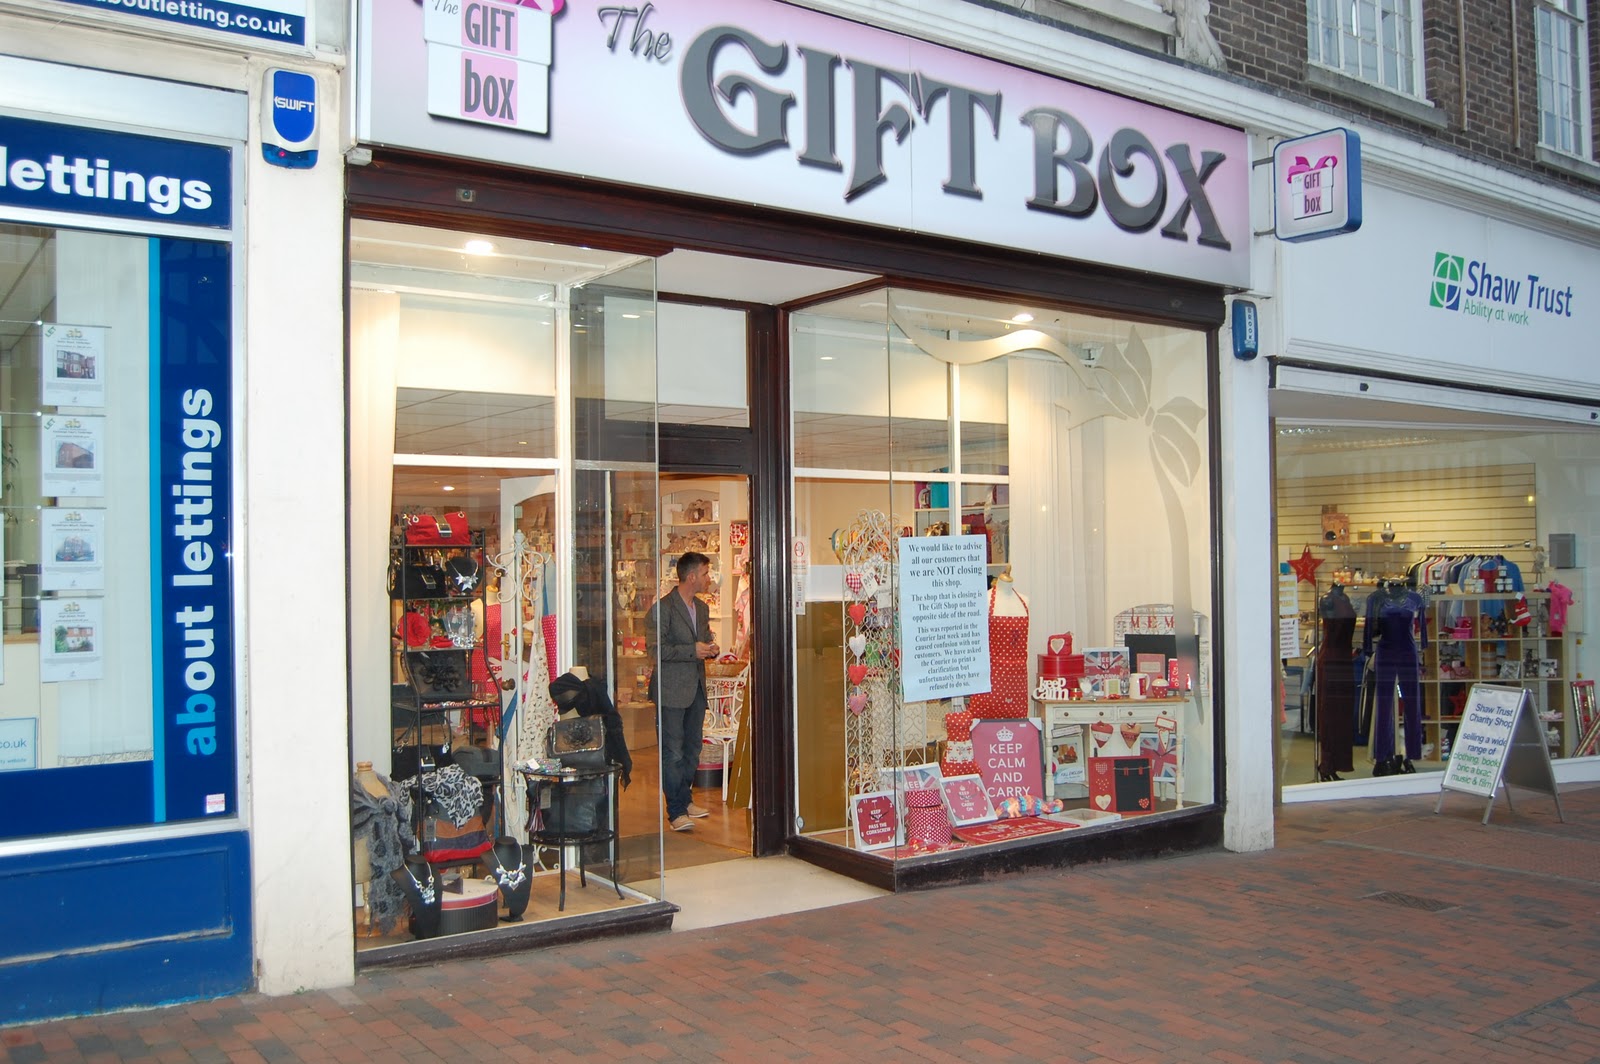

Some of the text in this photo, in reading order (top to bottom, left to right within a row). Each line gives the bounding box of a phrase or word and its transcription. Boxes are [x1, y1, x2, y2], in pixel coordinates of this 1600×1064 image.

[97, 0, 293, 36] outletting.co.uk
[464, 2, 515, 52] GIFT
[464, 58, 515, 121] box
[275, 96, 315, 113] SWIFT
[597, 2, 1232, 252] The GIFT BOX
[0, 146, 212, 215] lettings
[1304, 171, 1320, 190] GIFT
[1304, 194, 1321, 214] box
[1466, 260, 1573, 318] Shaw Trust
[1463, 298, 1530, 326] Ability at work
[44, 418, 56, 430] LET
[942, 543, 953, 551] like
[172, 388, 222, 756] about lettings
[937, 566, 955, 576] NOT
[957, 565, 982, 575] closing
[945, 579, 962, 588] shop.
[924, 593, 938, 602] shop
[958, 591, 976, 599] closing
[944, 601, 958, 610] Shop
[912, 614, 937, 623] opposite
[941, 624, 962, 633] reported
[914, 651, 942, 659] customers.
[958, 657, 971, 665] print
[928, 666, 959, 675] clarification
[918, 675, 954, 684] unfortunately
[1040, 676, 1066, 689] keep
[929, 683, 948, 691] refused
[1032, 687, 1070, 700] calm
[1475, 703, 1514, 717] Shaw Trust
[1469, 713, 1513, 730] Charity Shop
[1462, 732, 1484, 744] selling
[1491, 737, 1507, 747] wide
[990, 743, 1023, 754] KEEP
[1467, 744, 1497, 756] range of
[988, 758, 1026, 768] CALM
[1457, 763, 1469, 772] bric
[993, 772, 1023, 782] AND
[1451, 773, 1492, 788] music & film
[987, 786, 1030, 798] CARRY
